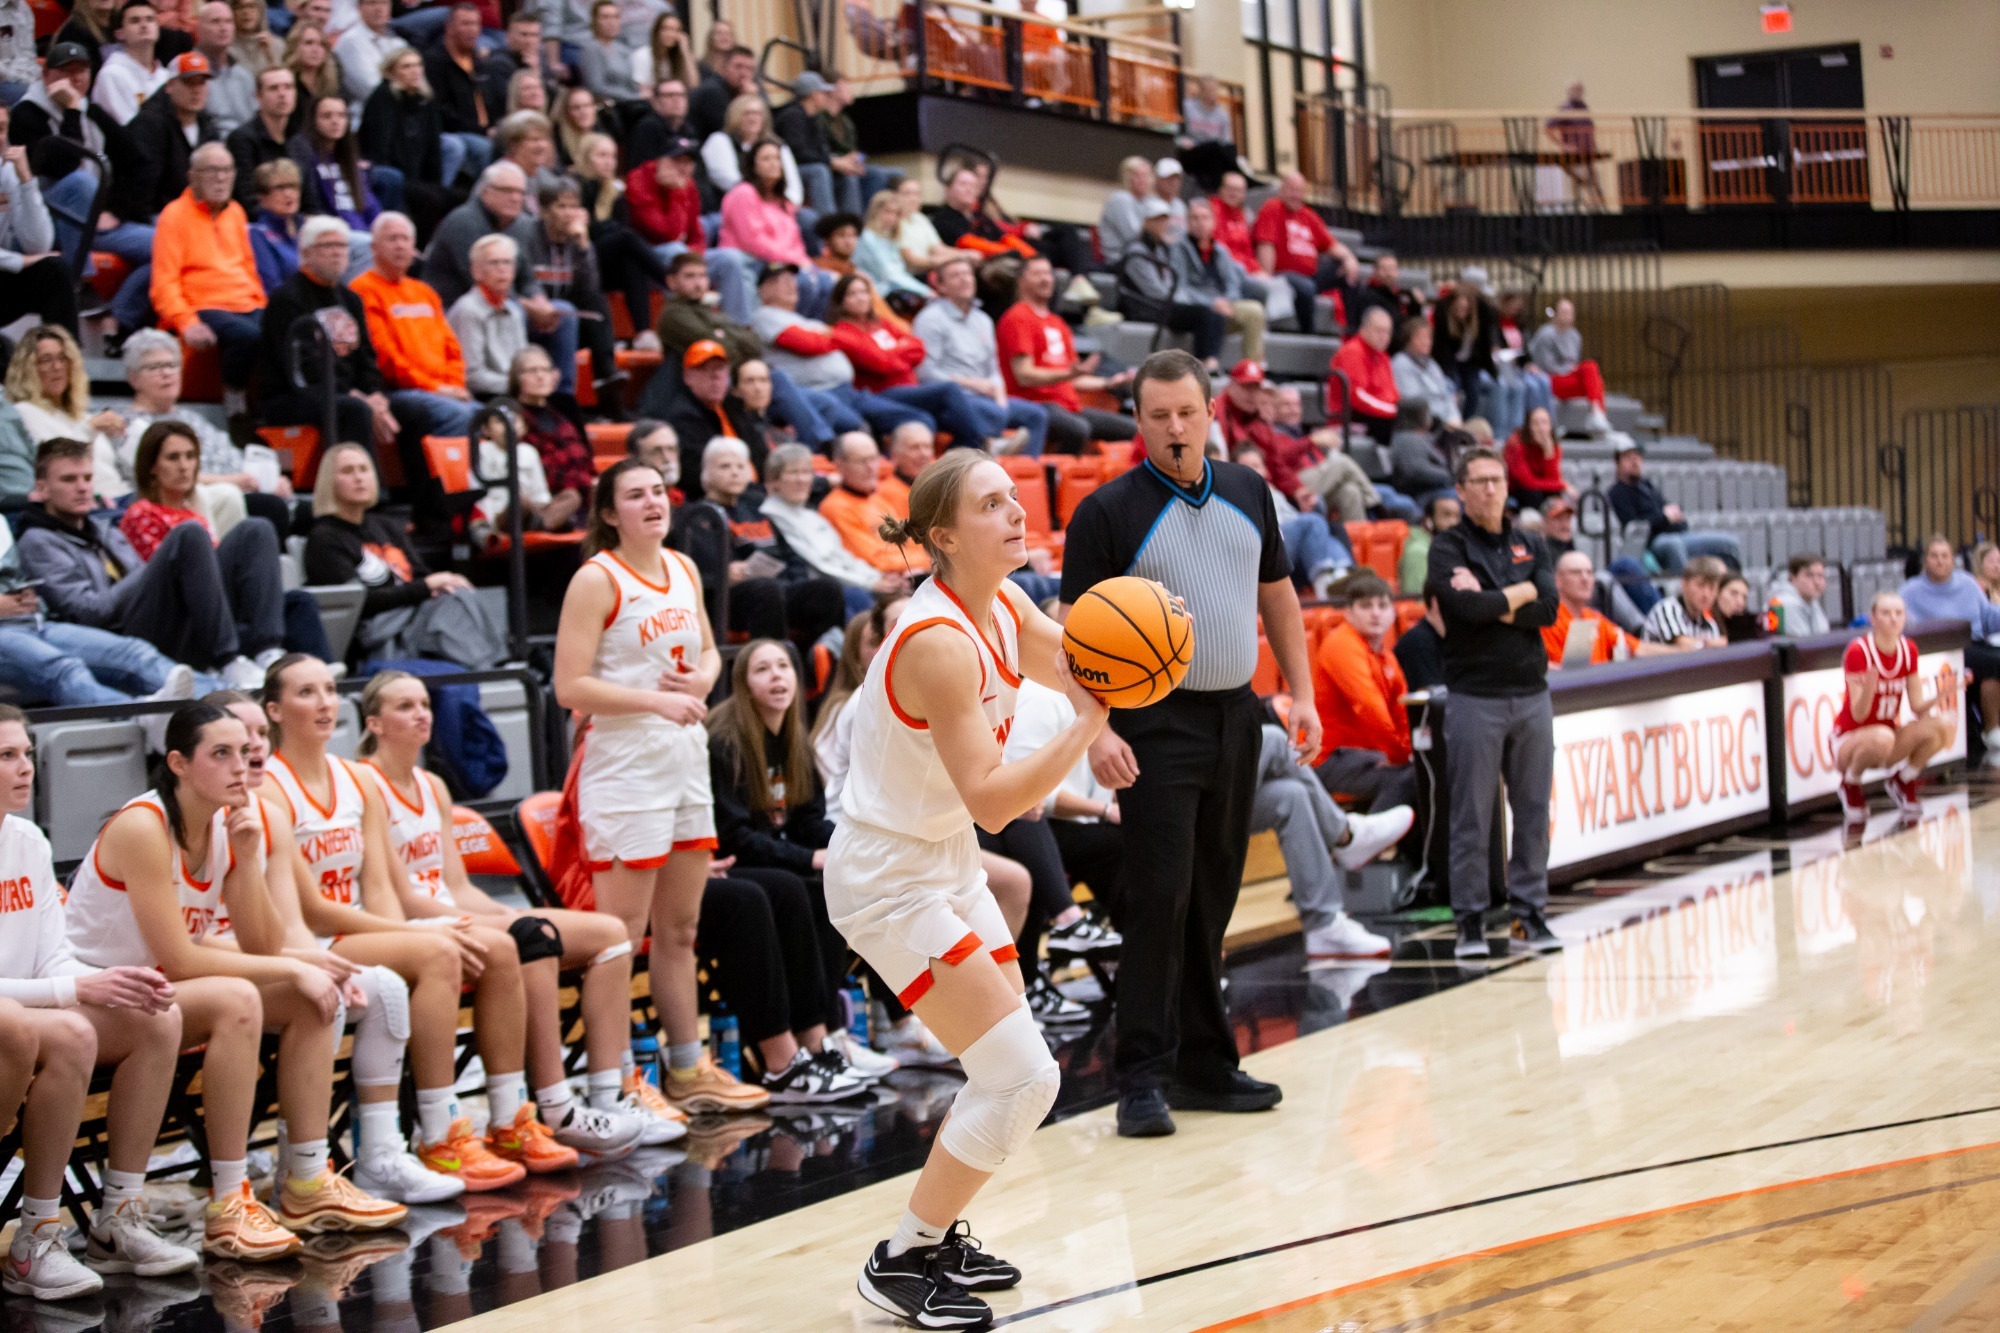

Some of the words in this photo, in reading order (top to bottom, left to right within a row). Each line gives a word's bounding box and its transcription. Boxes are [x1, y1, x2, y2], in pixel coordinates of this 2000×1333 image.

[638, 607, 699, 647] KNIGHT
[1067, 652, 1111, 685] lson
[1563, 708, 1761, 834] WARTBURG
[301, 826, 363, 864] KNIGHT
[452, 821, 490, 839] BURG
